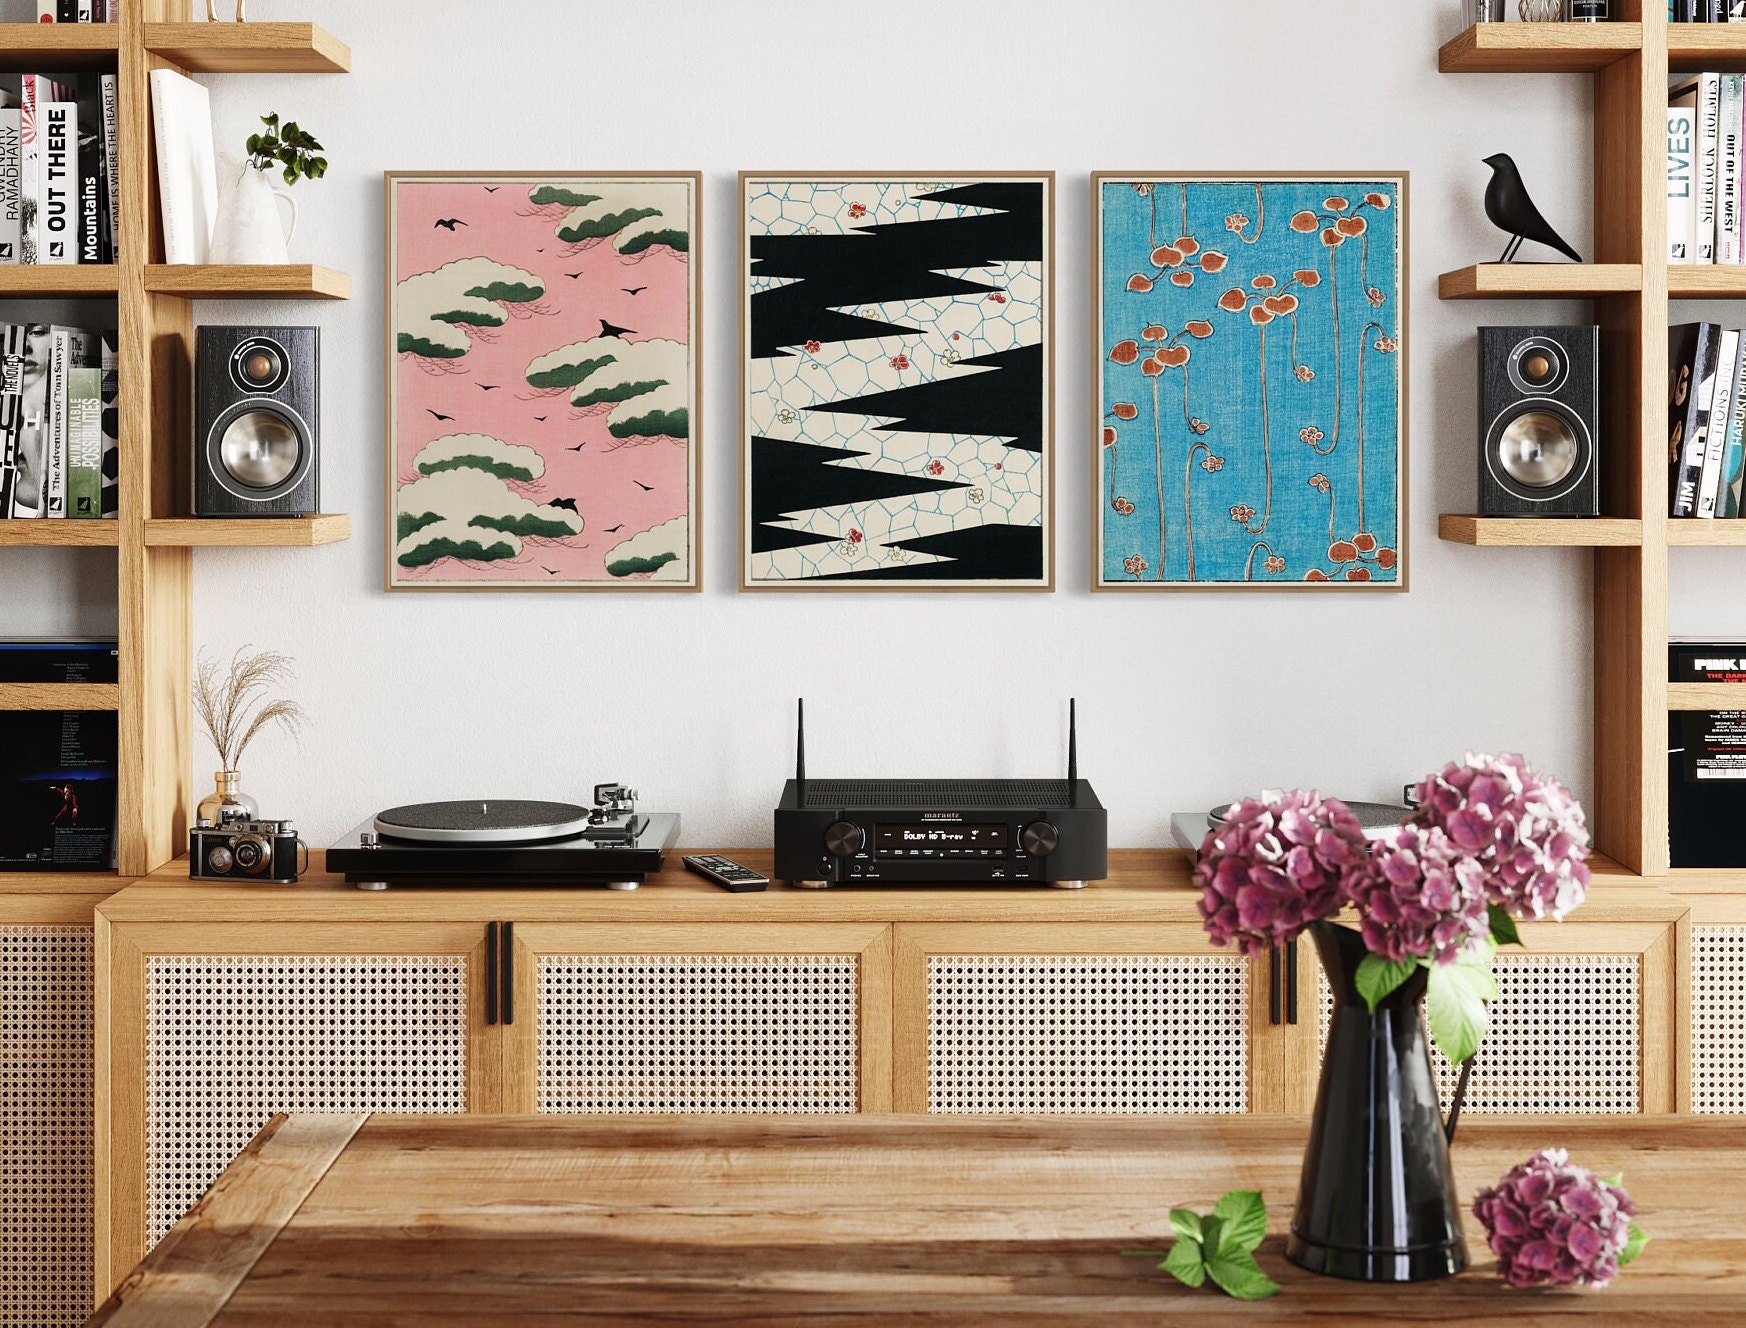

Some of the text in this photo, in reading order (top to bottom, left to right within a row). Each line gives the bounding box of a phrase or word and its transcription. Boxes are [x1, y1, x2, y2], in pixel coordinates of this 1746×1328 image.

[104, 82, 113, 91] IS
[105, 95, 116, 126] HEART
[107, 128, 117, 148] THE
[1701, 80, 1718, 223] SHERLOCK HOLMES
[1726, 134, 1736, 156] OUT
[6, 126, 19, 220] RAMADHANY
[48, 109, 66, 232] OUT THERE
[109, 151, 119, 188] WHERE
[1668, 117, 1690, 198] LIVES
[1726, 160, 1735, 174] OF
[1725, 177, 1734, 199] THE
[82, 176, 98, 260] Mountains
[1724, 201, 1734, 233] WEST
[6, 354, 20, 380] NOVELS
[4, 379, 17, 393] THE
[52, 335, 65, 492] The Adventures of Tom Sawyer
[1707, 389, 1729, 461] FICTIONS
[1730, 399, 1746, 446] HARUKI
[69, 398, 82, 467] UNIMAGINABLE
[81, 398, 100, 468] POSSIBILITIES
[1678, 481, 1696, 512] JIM
[1694, 658, 1739, 671] PINK
[904, 833, 926, 841] DOLBY
